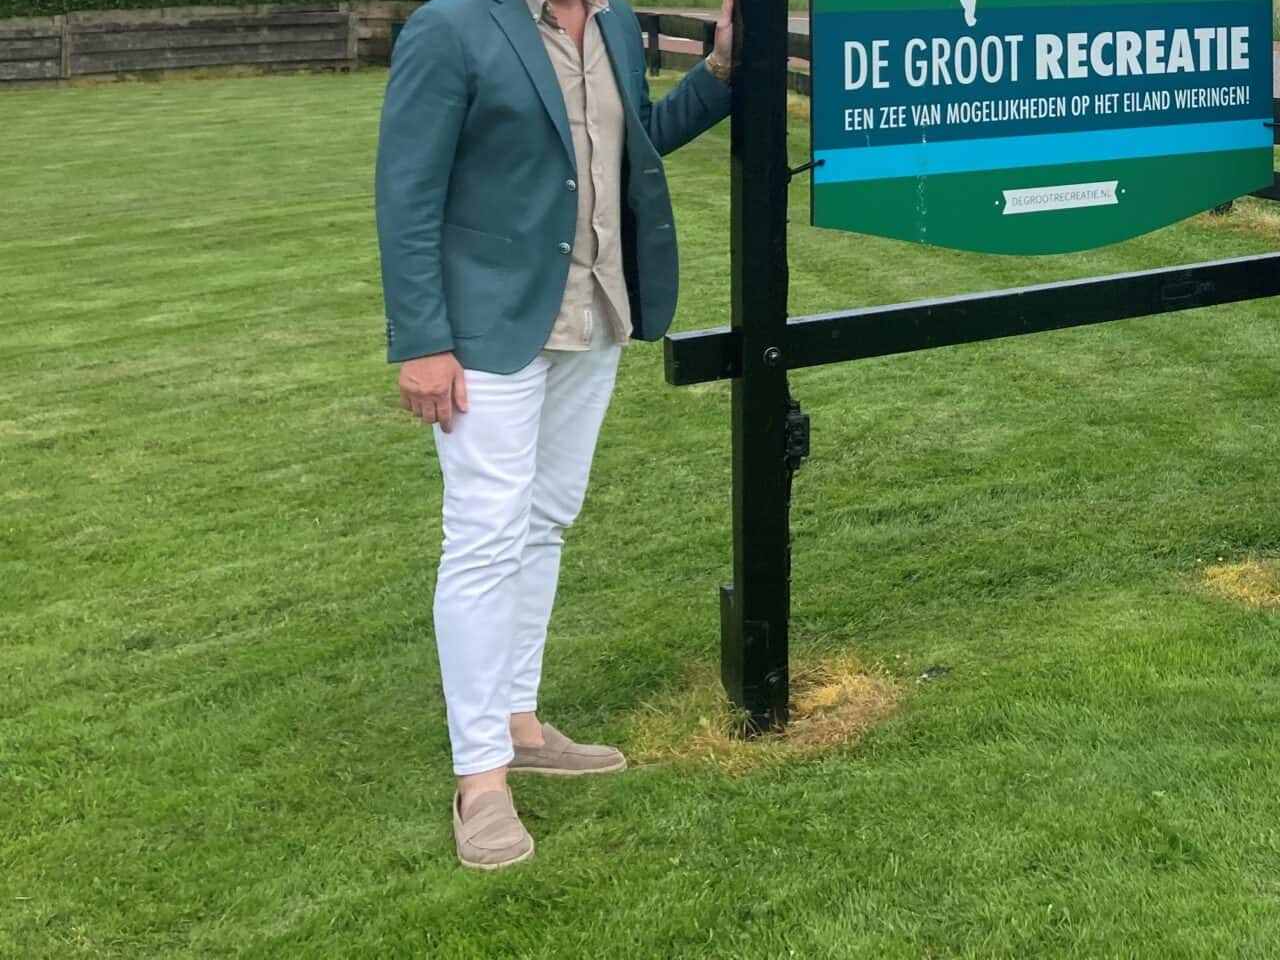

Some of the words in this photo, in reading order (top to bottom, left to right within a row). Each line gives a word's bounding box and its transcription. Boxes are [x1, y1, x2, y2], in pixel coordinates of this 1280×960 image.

[845, 40, 889, 90] DE
[905, 35, 1023, 86] GROOT
[1036, 27, 1249, 80] RECREATIE
[845, 108, 873, 130] EEN
[880, 106, 906, 128] ZEE
[912, 104, 940, 125] VAN
[947, 97, 1065, 124] MOGELIJKHEDEN
[1072, 96, 1089, 115] OP
[1095, 94, 1119, 114] HET
[1124, 91, 1170, 112] EILAND
[1175, 86, 1249, 108] WIERINGEN!
[1011, 189, 1112, 207] DEGROOTRECREATIE.NL
